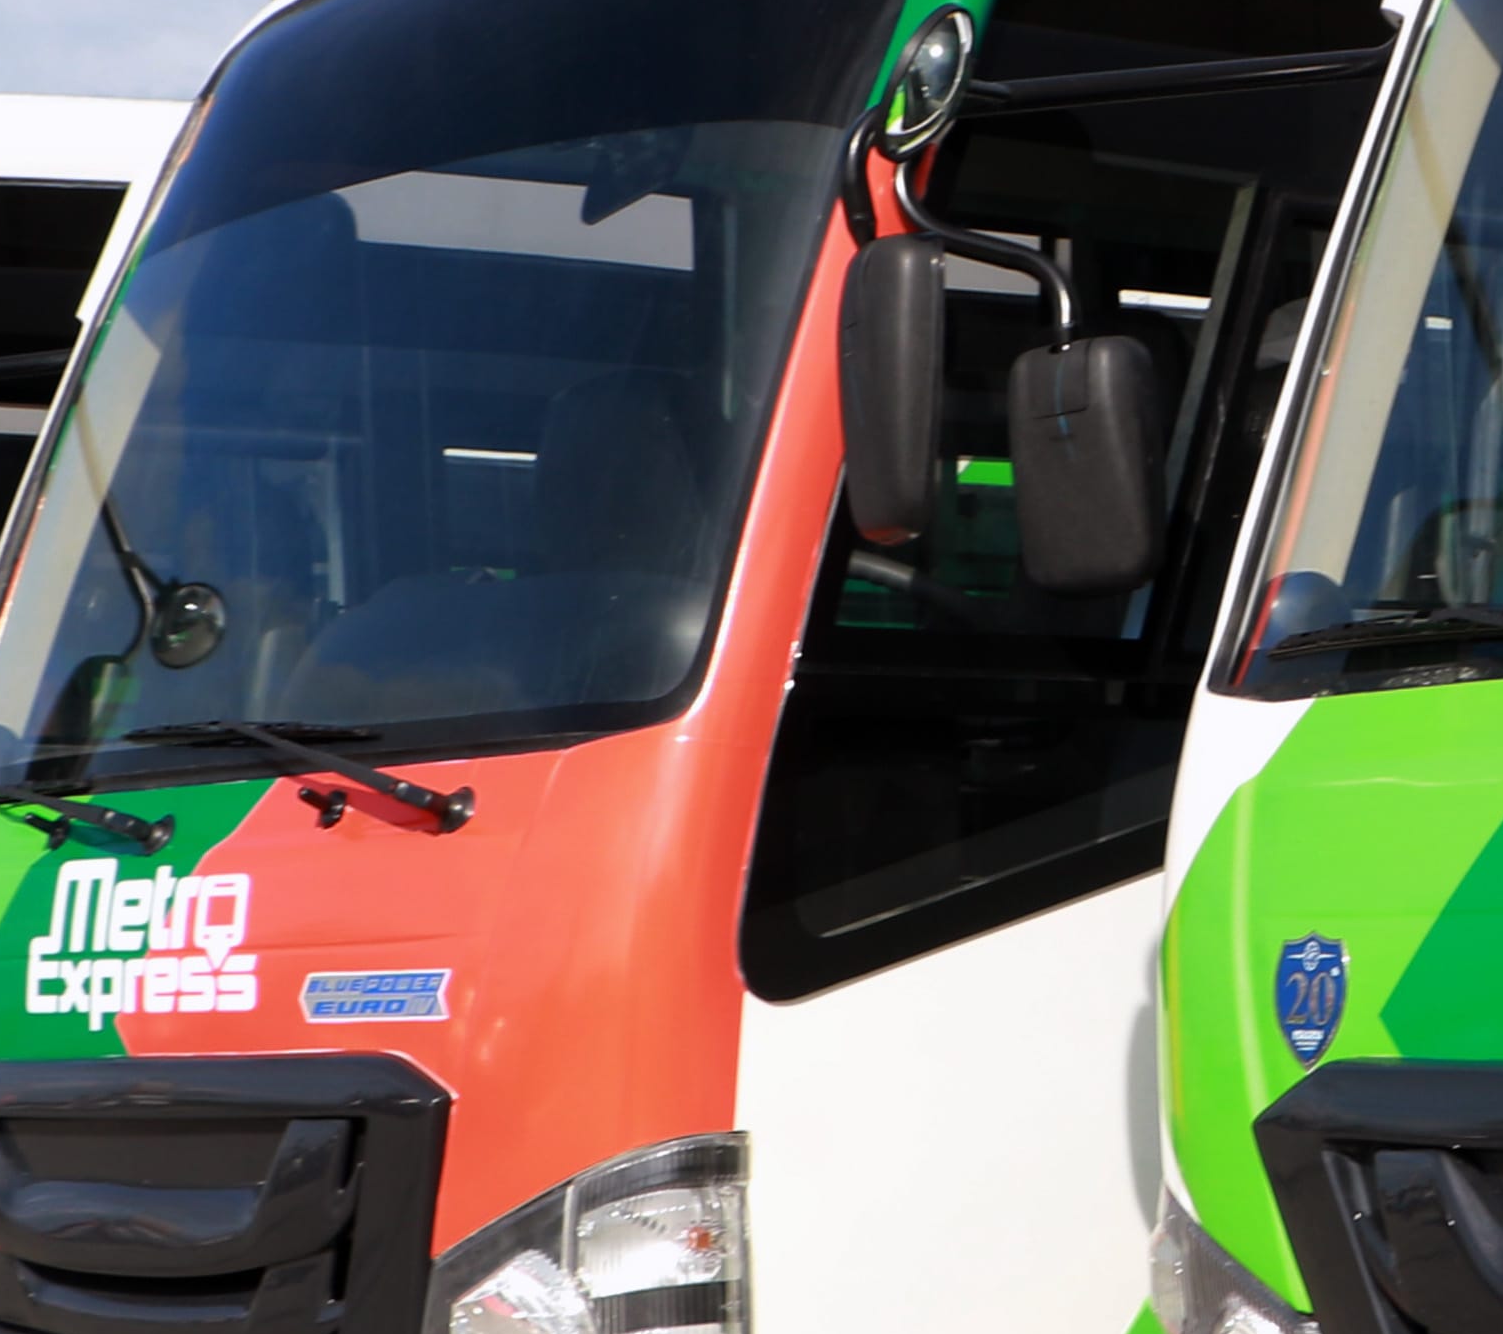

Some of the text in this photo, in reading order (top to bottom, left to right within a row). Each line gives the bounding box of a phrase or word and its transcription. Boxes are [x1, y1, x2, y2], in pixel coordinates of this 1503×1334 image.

[33, 858, 251, 956] Metro
[25, 939, 258, 1031] Express
[312, 998, 408, 1016] EURO
